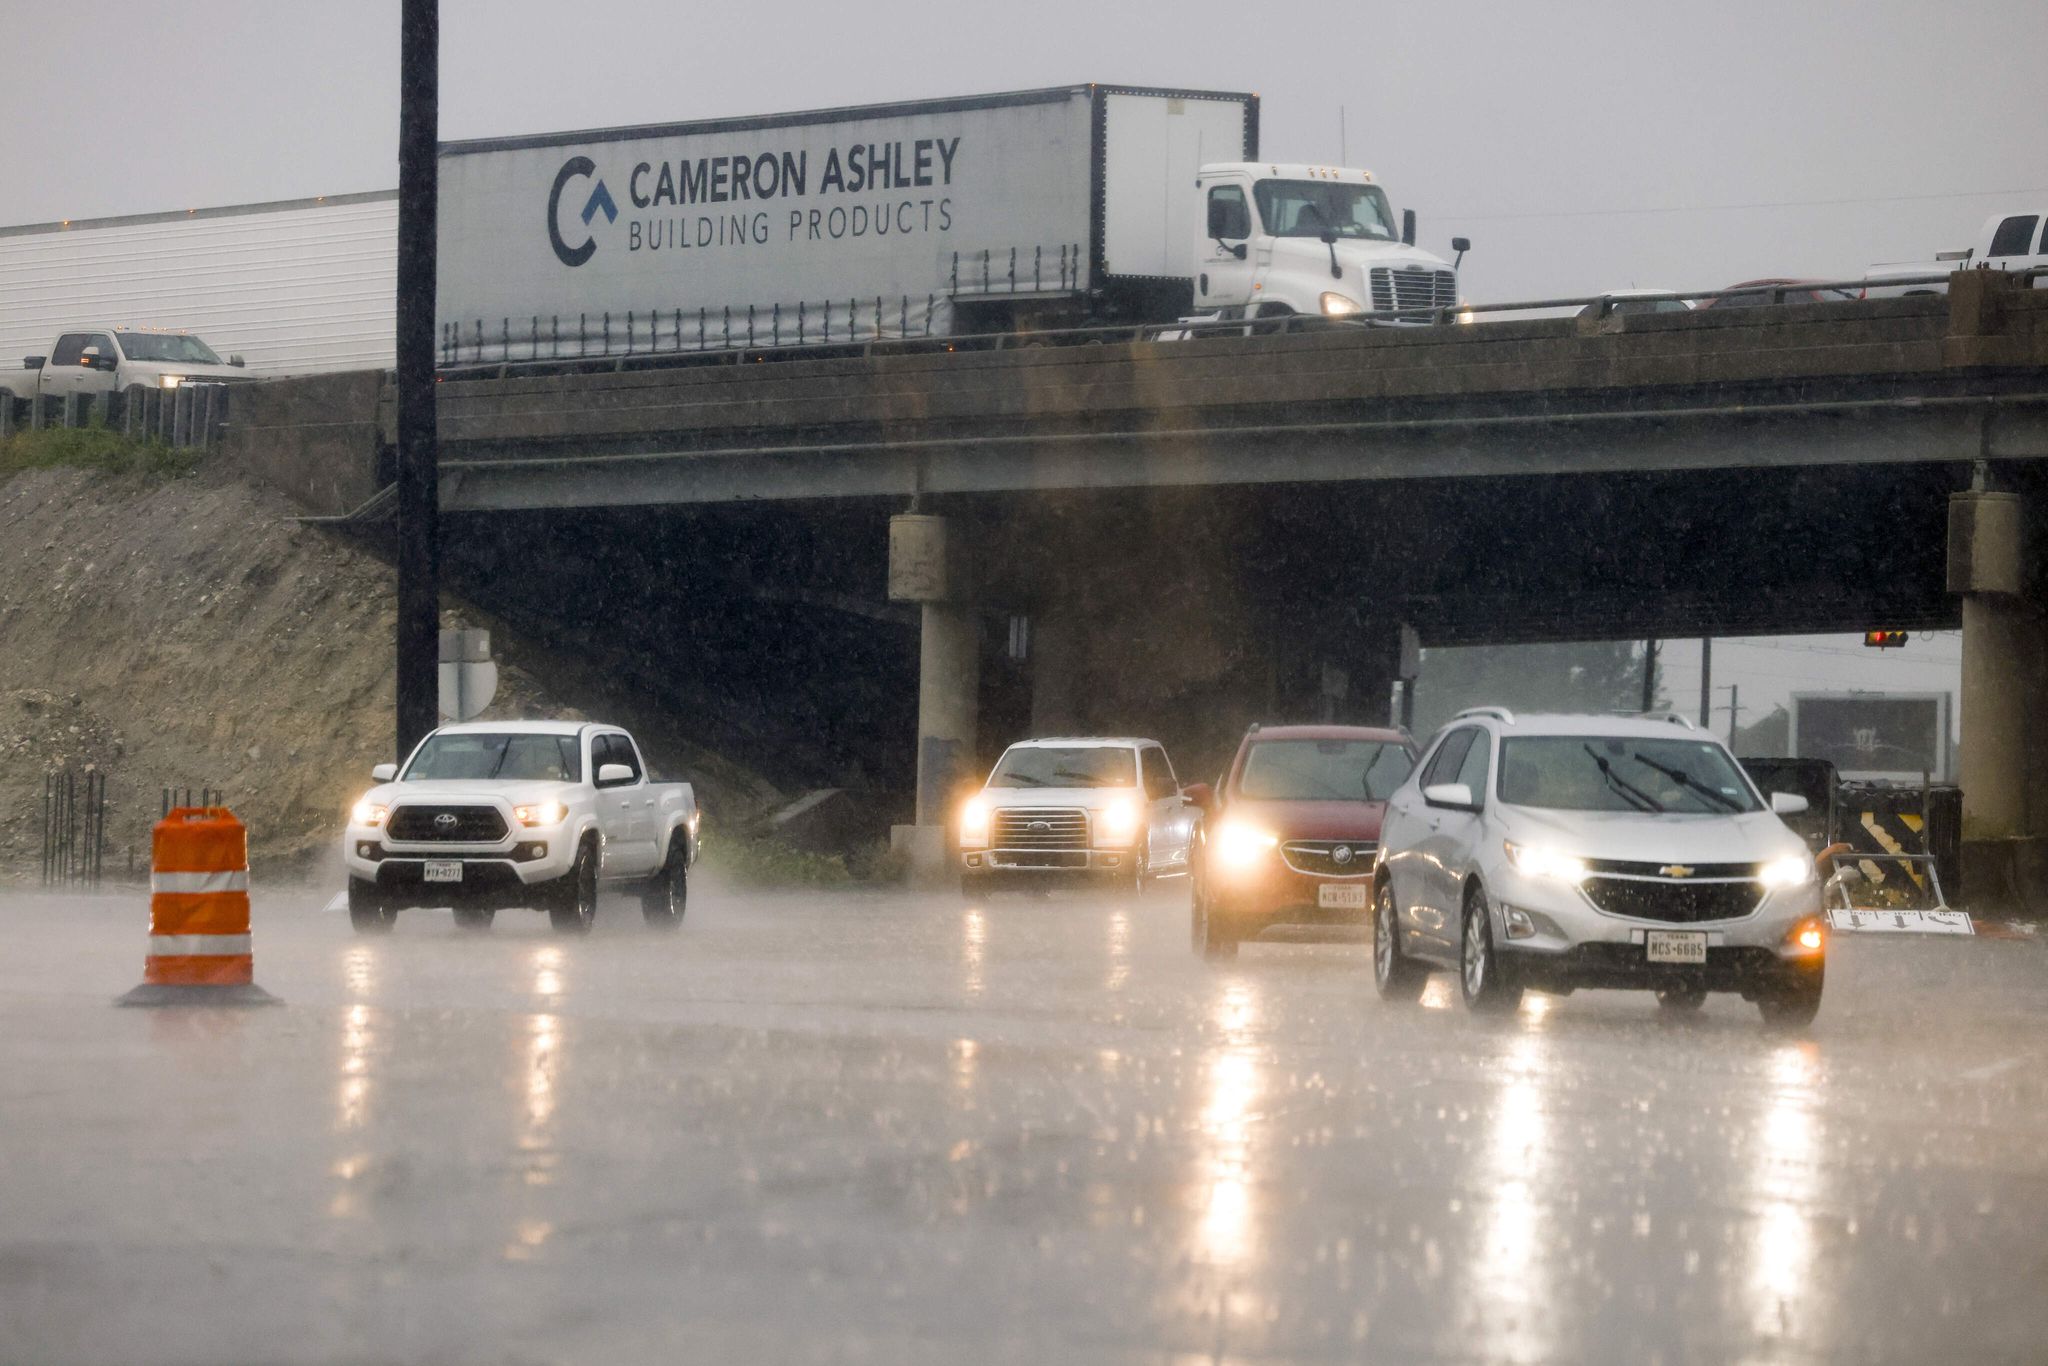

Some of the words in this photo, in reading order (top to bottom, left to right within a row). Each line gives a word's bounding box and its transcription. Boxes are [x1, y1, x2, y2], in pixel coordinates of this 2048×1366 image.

[629, 149, 807, 208] CAMERON
[819, 137, 961, 194] ASHLEY
[629, 212, 769, 251] BUILDING
[790, 198, 953, 241] PRODUCTS
